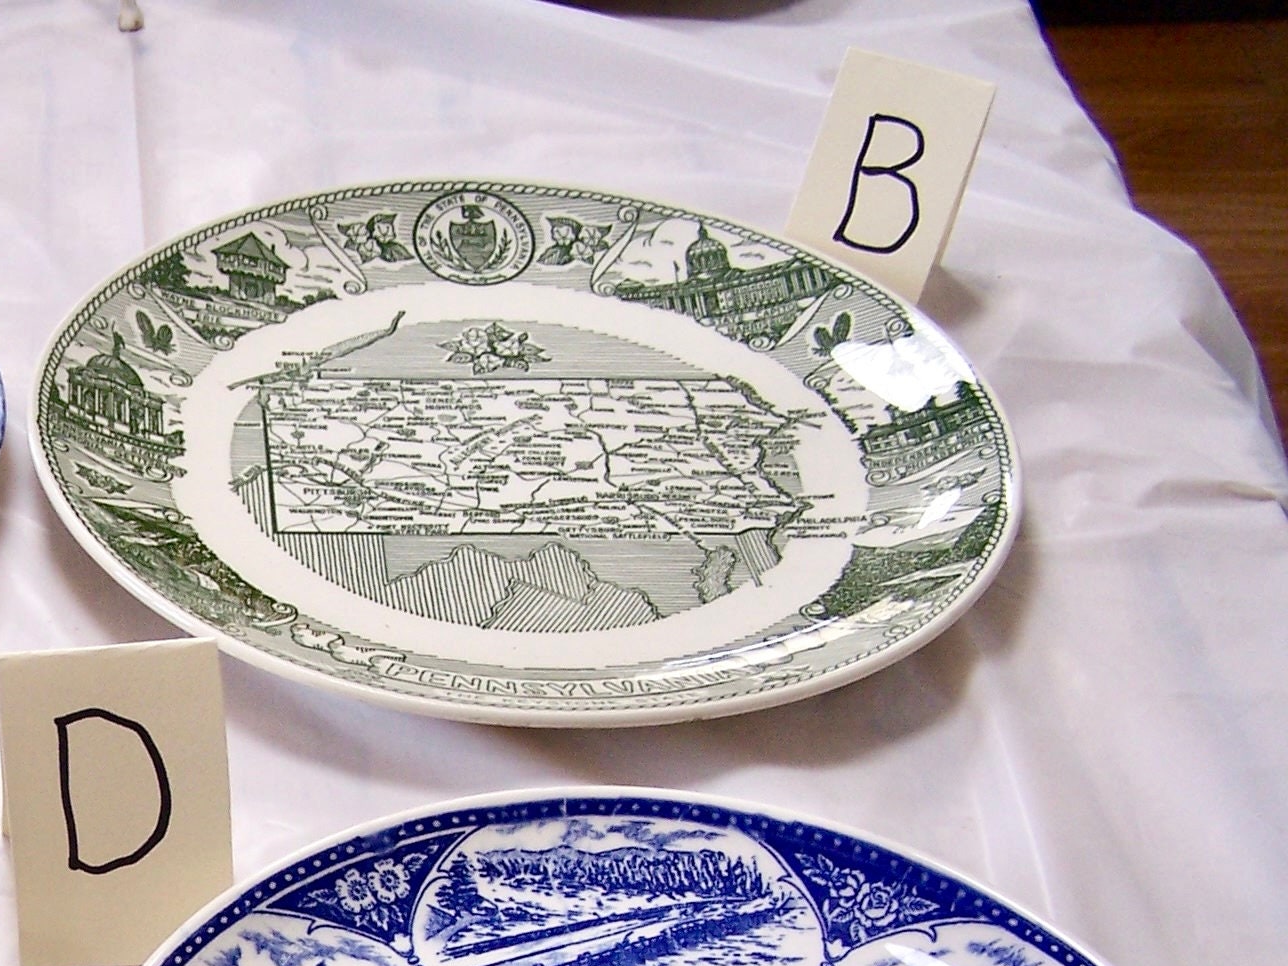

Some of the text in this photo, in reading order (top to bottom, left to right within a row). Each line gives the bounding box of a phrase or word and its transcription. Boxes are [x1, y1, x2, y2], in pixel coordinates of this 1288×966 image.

[435, 194, 466, 212] STATE
[475, 194, 489, 203] OF
[833, 113, 925, 254] B
[53, 708, 172, 875] D
